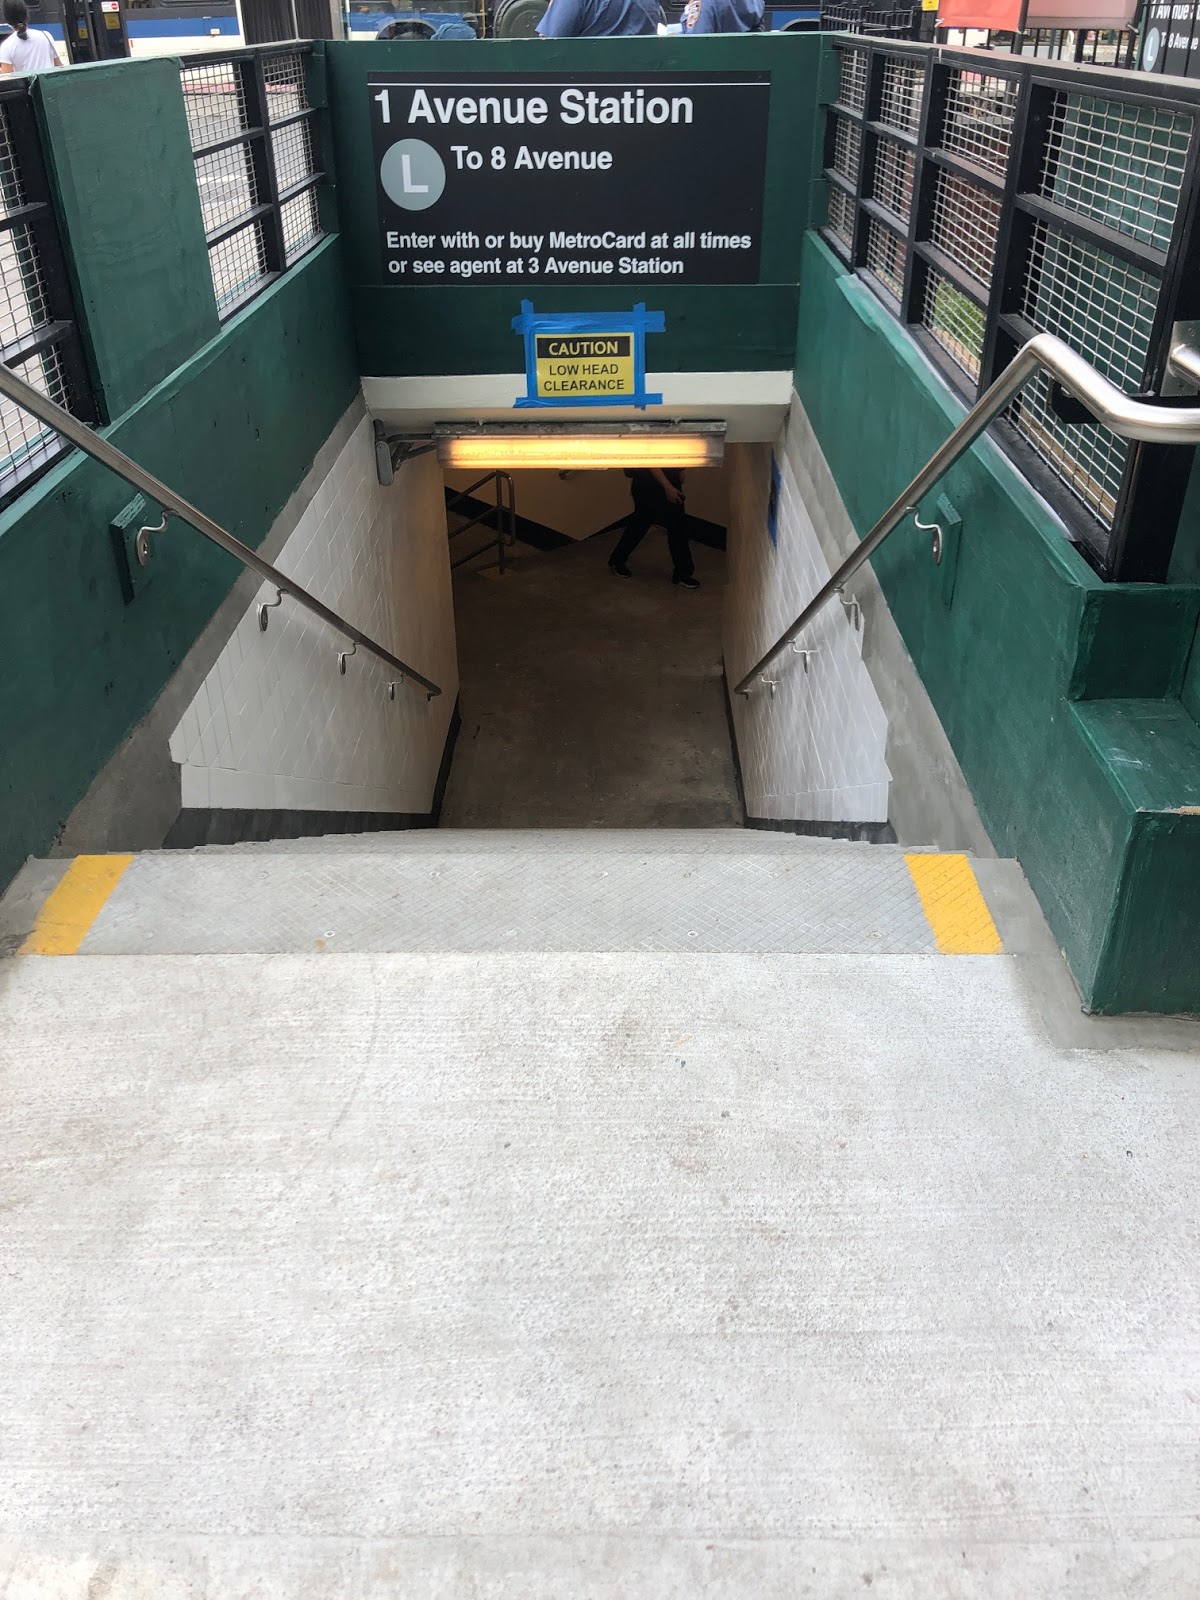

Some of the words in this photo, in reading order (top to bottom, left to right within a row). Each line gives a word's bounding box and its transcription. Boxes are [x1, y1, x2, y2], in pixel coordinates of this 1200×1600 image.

[1156, 0, 1190, 20] Avnue
[1147, 36, 1154, 62] L
[1168, 32, 1175, 49] 8
[374, 89, 391, 124] 1
[407, 88, 549, 125] Avenue
[559, 88, 694, 125] Station
[450, 145, 484, 170] To
[490, 145, 507, 170] 8
[514, 145, 613, 170] Avenue
[401, 154, 429, 193] L
[386, 231, 437, 249] Enter
[441, 230, 480, 249] with
[484, 234, 505, 249] or
[509, 231, 545, 253] buy
[549, 231, 646, 249] MetroCard
[650, 232, 669, 249] at
[672, 231, 696, 249] all
[700, 231, 752, 249] times
[388, 260, 408, 274] or
[412, 260, 445, 274] see
[449, 257, 502, 278] agent
[506, 257, 524, 274] at
[528, 256, 540, 274] 3
[544, 256, 614, 274] Avenue
[618, 256, 684, 274] Station
[548, 341, 619, 356] CAUTION
[549, 365, 580, 376] LOW
[582, 364, 619, 375] HEAD
[543, 379, 625, 392] CLEARANCE
